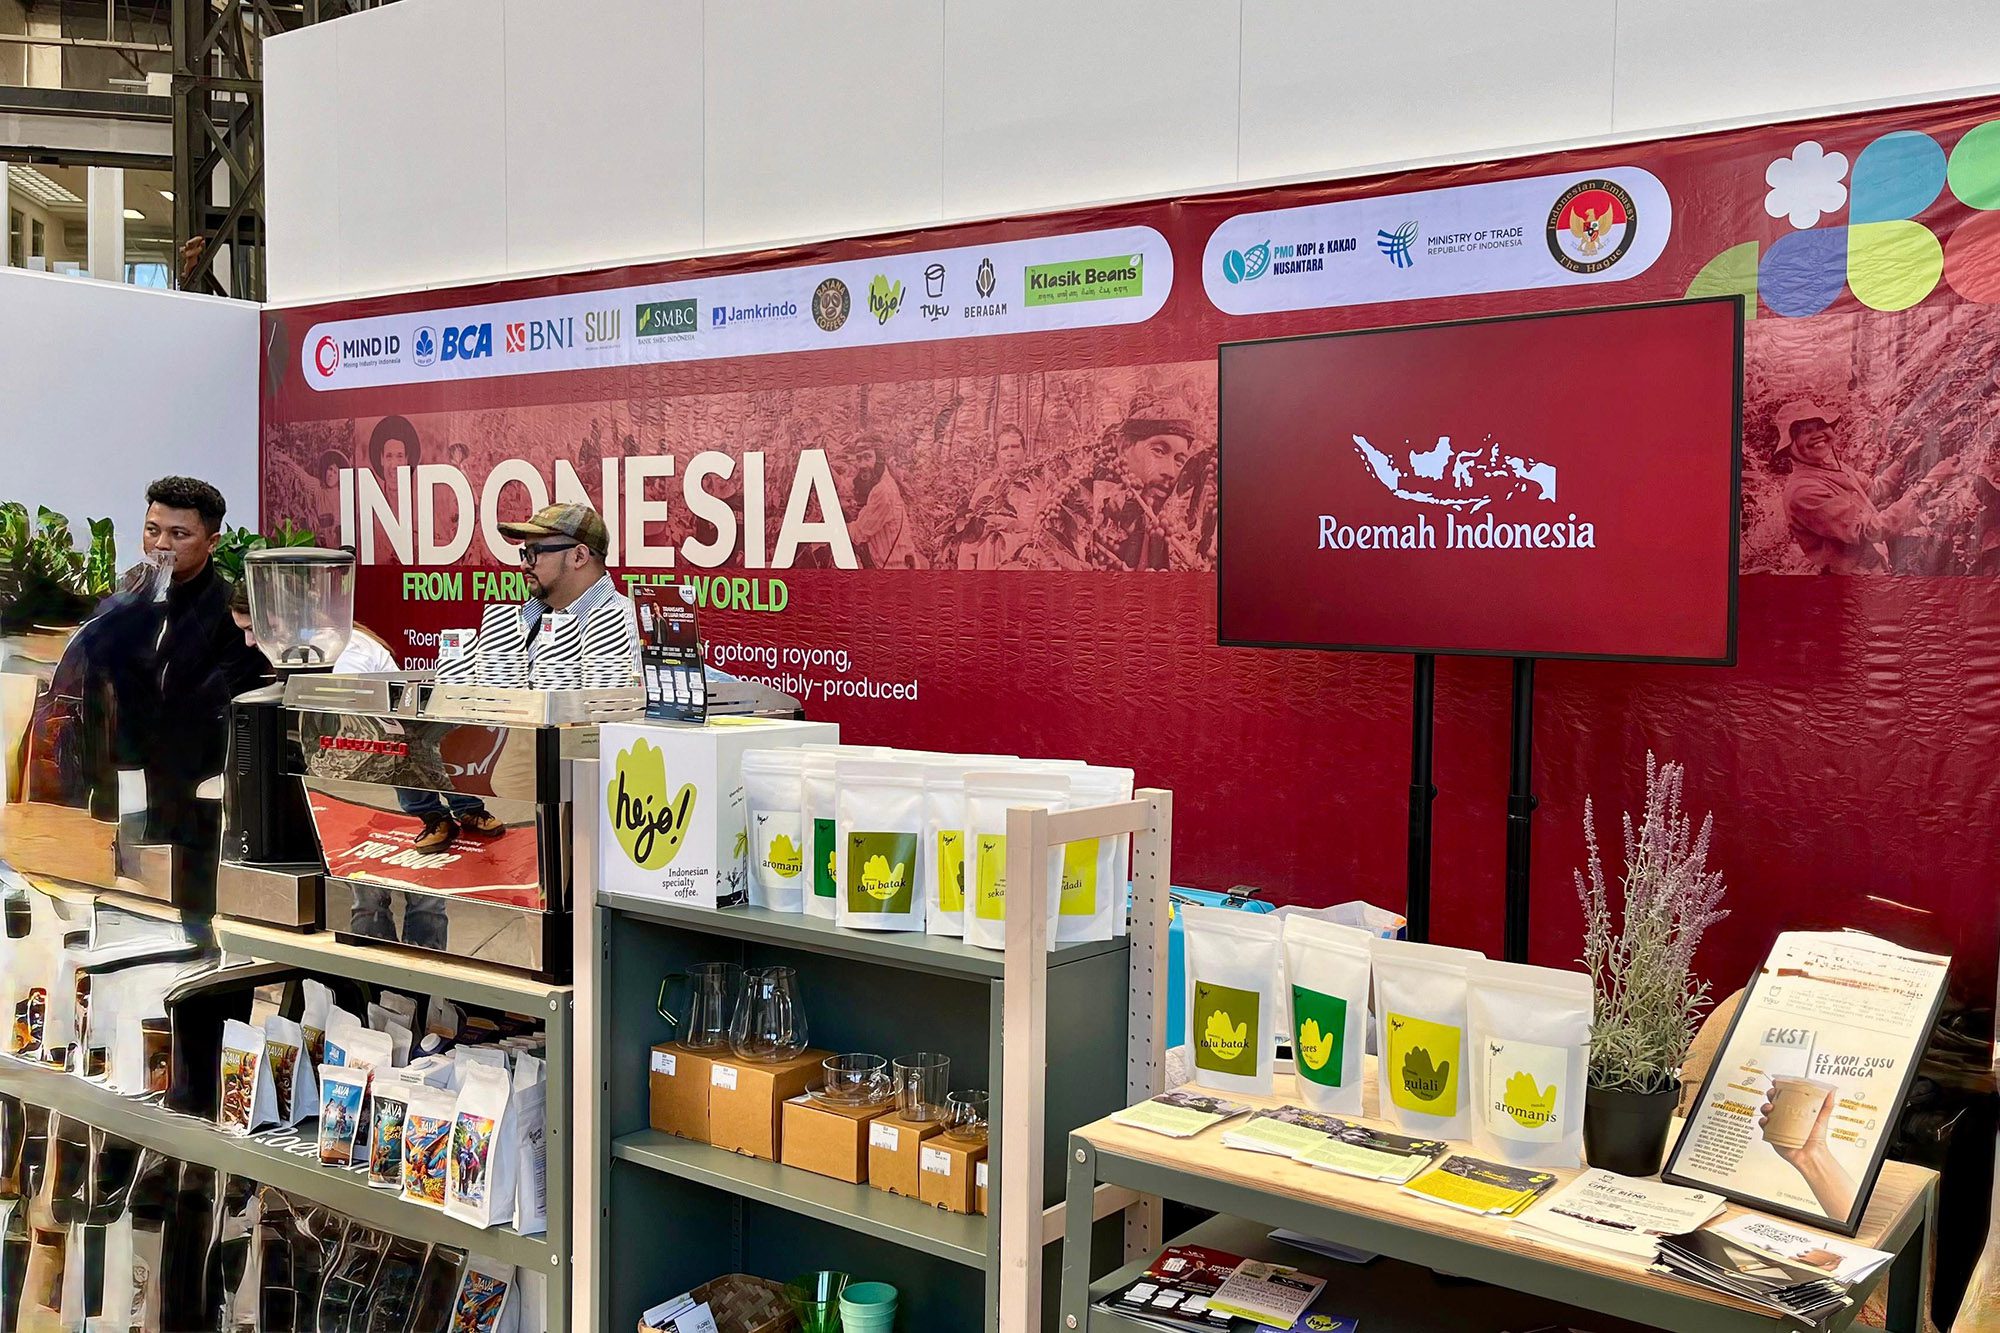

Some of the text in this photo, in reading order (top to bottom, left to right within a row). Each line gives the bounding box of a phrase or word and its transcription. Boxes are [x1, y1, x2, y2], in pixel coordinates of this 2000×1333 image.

[1548, 181, 1635, 230] Indonesian Embassy
[1427, 227, 1523, 246] MINISTRY OF TRADE
[1274, 238, 1357, 259] PMO KOPI & KAKAO
[1427, 238, 1523, 256] REPUBLIC OF INDONESIA
[1273, 258, 1324, 275] NUSANTARA
[1560, 248, 1623, 273] The Hague
[1030, 267, 1137, 289] Klasik Beans
[816, 279, 846, 297] RAYANA
[728, 300, 798, 322] Jamkrindo
[870, 284, 906, 326] hejo!
[920, 304, 950, 320] TUKU
[964, 303, 1007, 318] BERAGAM
[585, 308, 621, 343] SUJI
[654, 307, 694, 329] SMBC
[816, 315, 847, 331] COFFEES
[440, 322, 493, 361] BCA
[529, 316, 575, 351] BNI
[343, 335, 401, 359] MIND ID
[339, 449, 859, 570] INDONESIA
[1318, 512, 1596, 550] Roemah Indonesia
[402, 571, 463, 601] FROM
[683, 574, 789, 613] WORLD
[714, 641, 778, 669] gotong
[783, 647, 852, 673] royong,
[616, 770, 691, 864] hejo!
[668, 866, 709, 877] Indonesian
[762, 858, 803, 872] aromani
[662, 877, 695, 890] specialty
[674, 887, 699, 898] coffee.
[857, 878, 906, 893] tolu batak
[1200, 1038, 1250, 1049] tolu batak
[1765, 1027, 1810, 1045] EKST
[1816, 1053, 1895, 1069] ES KOPI SUSU
[1814, 1064, 1874, 1078] TETANGGA
[332, 1085, 350, 1097] JAVA
[1404, 1077, 1439, 1092] gulali
[382, 1101, 402, 1118] JAVA
[1494, 1100, 1558, 1124] aromanis
[420, 1120, 439, 1135] JAVA
[474, 1277, 494, 1293] JAVA
[1307, 1313, 1343, 1331] hejo!
